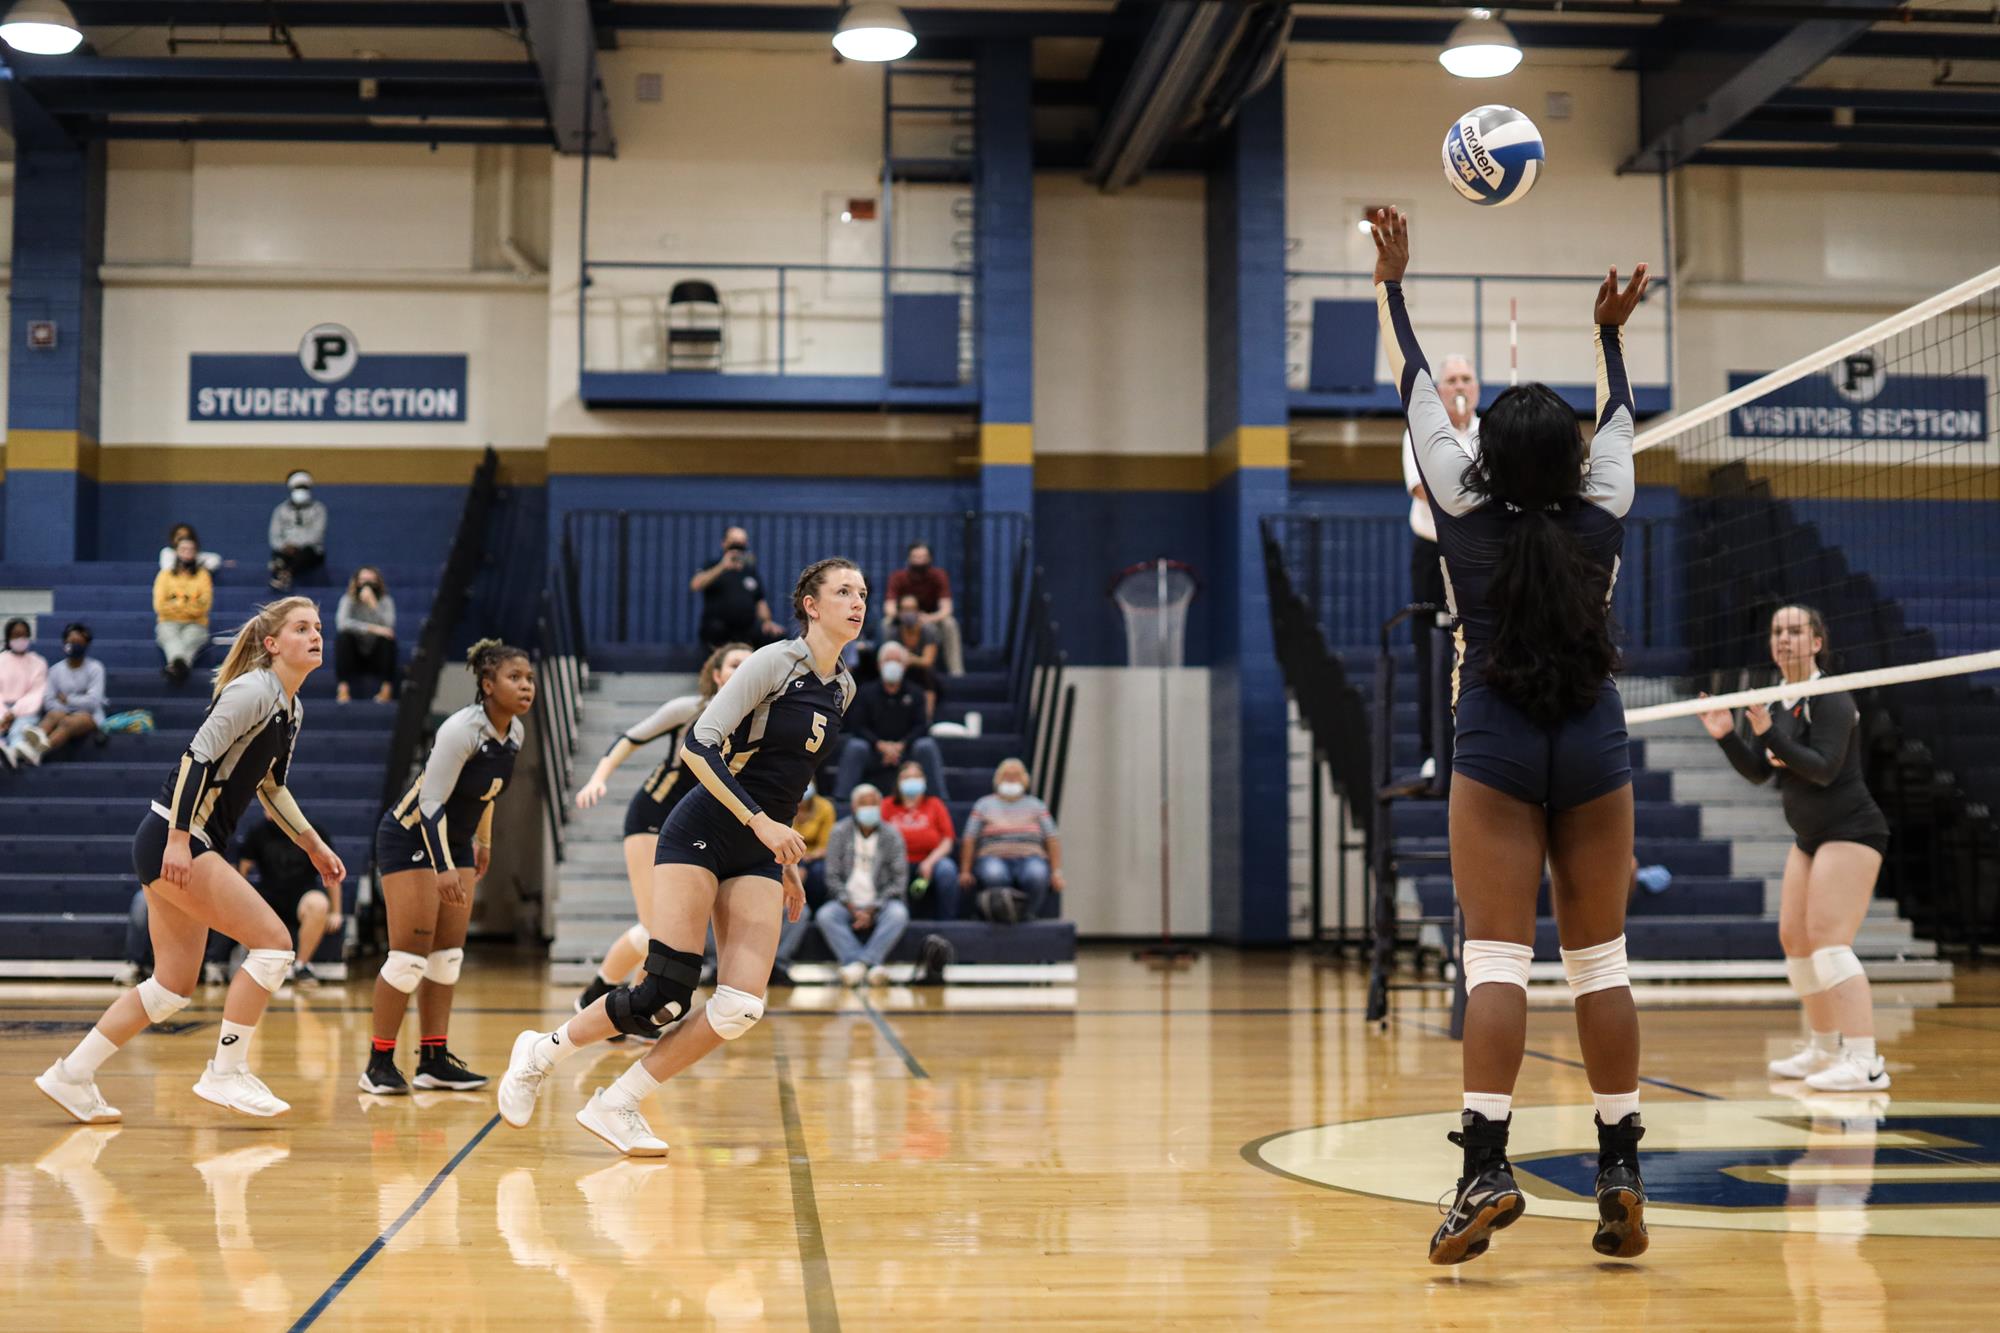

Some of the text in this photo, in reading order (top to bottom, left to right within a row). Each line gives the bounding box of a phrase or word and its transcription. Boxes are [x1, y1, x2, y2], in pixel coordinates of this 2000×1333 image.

[1450, 138, 1478, 182] NCAA
[1463, 126, 1495, 177] molten
[312, 335, 347, 371] P
[1843, 357, 1875, 391] P
[197, 387, 458, 417] STUDENT SECTION
[1739, 405, 1982, 437] VISITOR SECTION
[805, 711, 828, 753] 5
